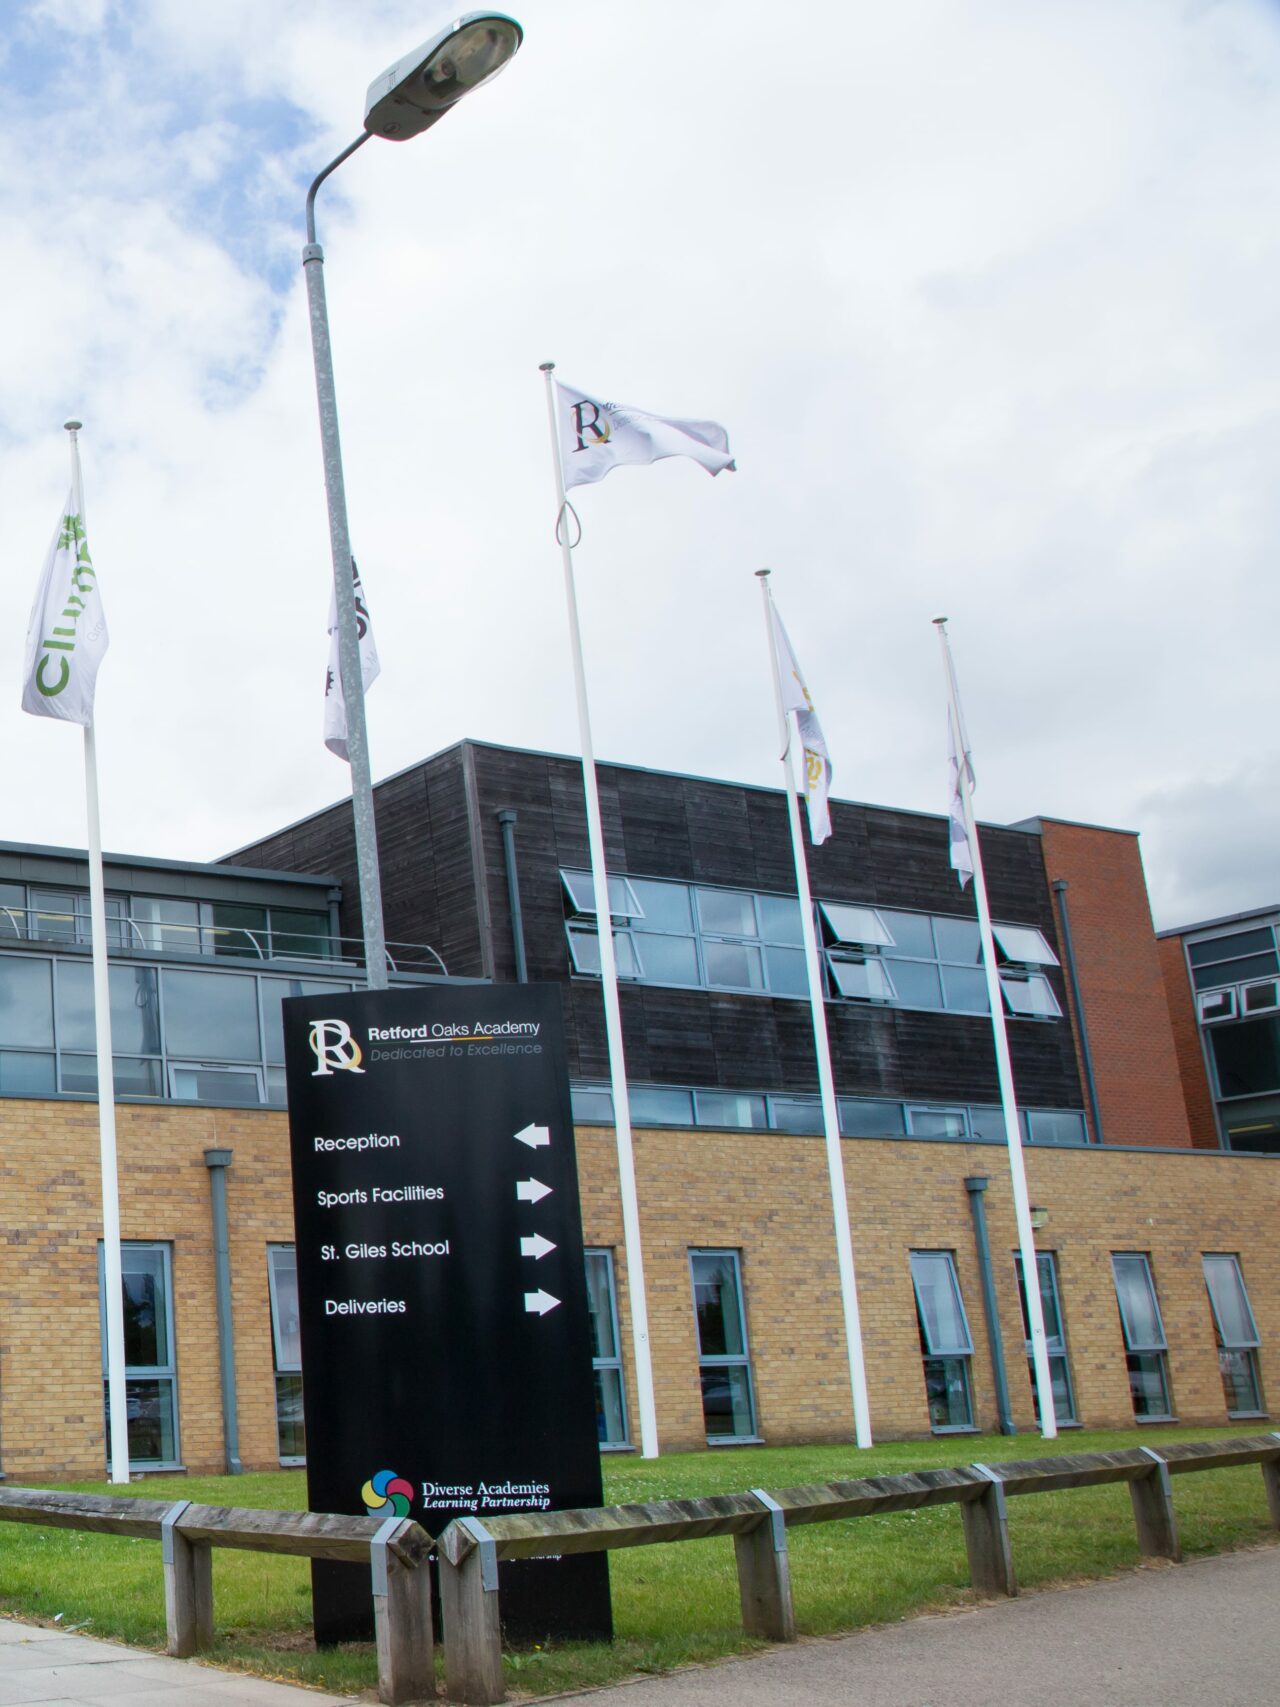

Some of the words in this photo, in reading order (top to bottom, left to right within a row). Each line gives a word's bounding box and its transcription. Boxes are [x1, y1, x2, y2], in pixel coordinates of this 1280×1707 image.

[570, 400, 612, 453] R
[368, 1024, 428, 1041] Retford
[431, 1023, 470, 1037] Oaks
[473, 1020, 540, 1037] Academy
[309, 1019, 366, 1077] R
[370, 1046, 445, 1062] Dedicated
[449, 1046, 463, 1058] to
[467, 1042, 543, 1057] Excellence
[314, 1133, 400, 1152] Reception
[317, 1188, 368, 1208] Sports
[372, 1185, 444, 1202] Facilities
[321, 1244, 340, 1261] St.
[345, 1242, 387, 1259] Giles
[391, 1239, 450, 1257] School
[325, 1297, 407, 1316] Deliveries
[422, 1482, 473, 1496] Diverse
[477, 1480, 549, 1495] Academies
[424, 1497, 478, 1511] Learning
[481, 1495, 550, 1509] Partnership
